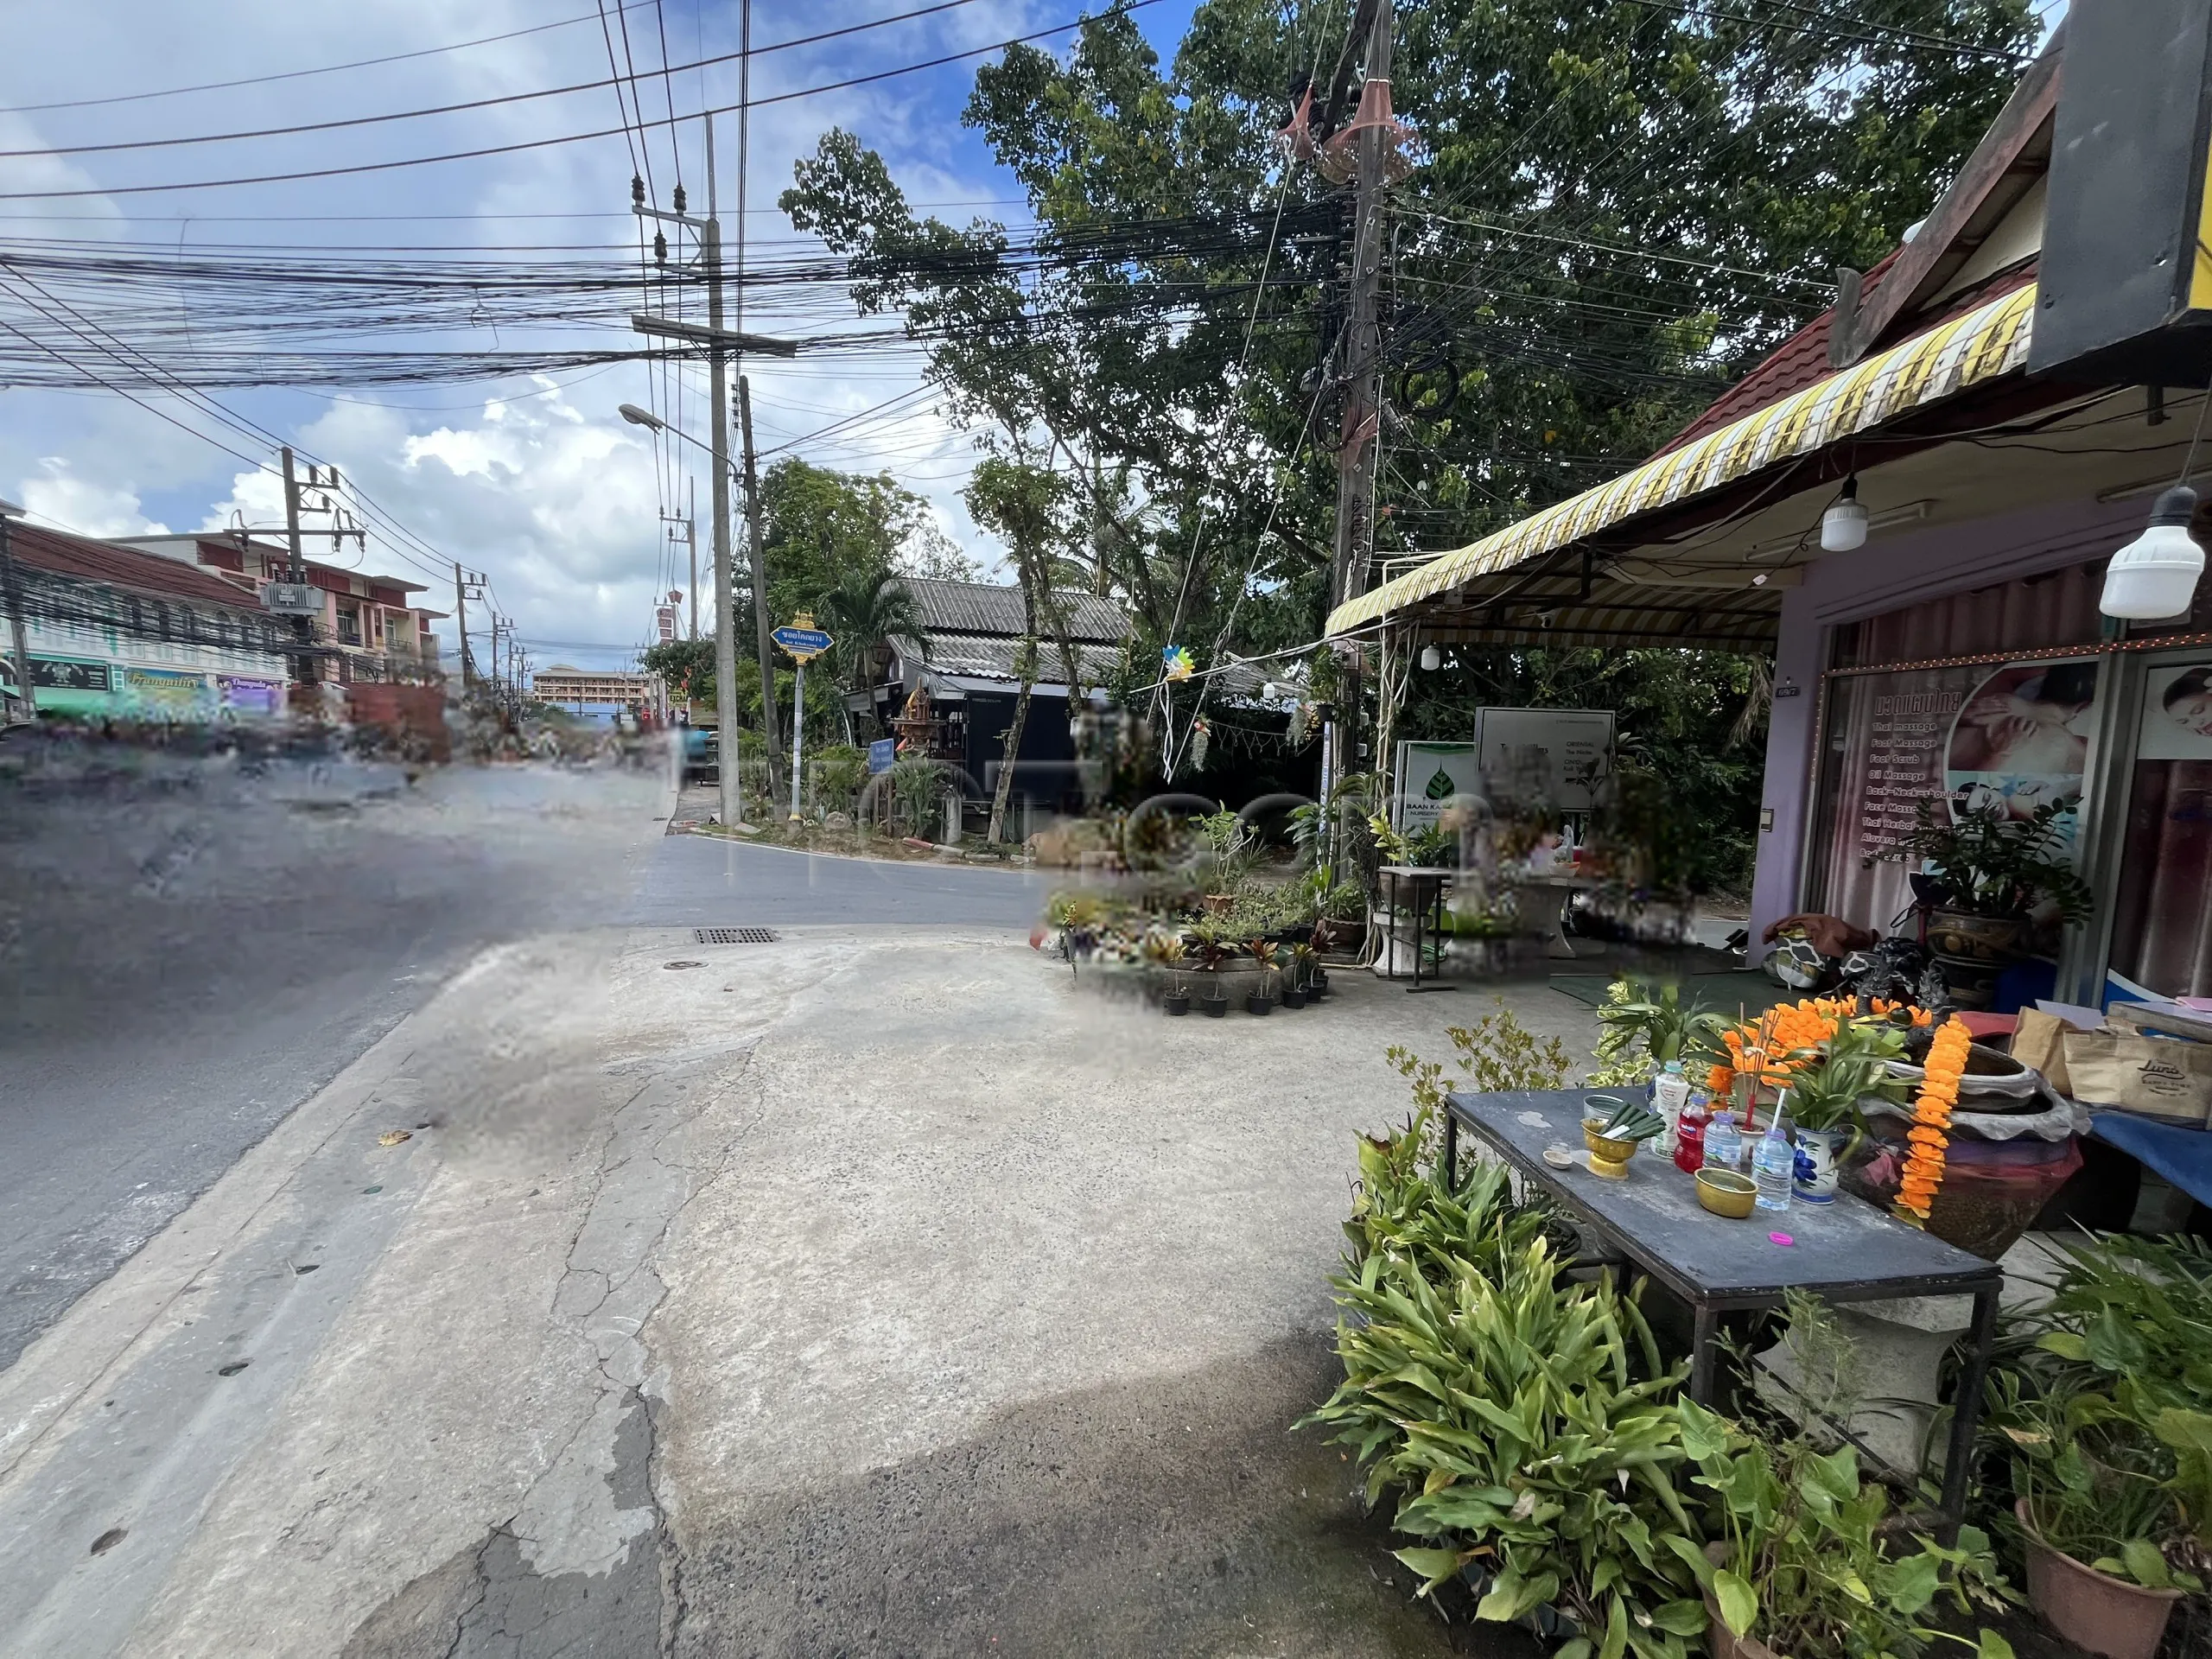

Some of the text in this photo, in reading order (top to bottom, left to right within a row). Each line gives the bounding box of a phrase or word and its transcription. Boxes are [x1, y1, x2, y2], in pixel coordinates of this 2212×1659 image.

[1875, 688, 1962, 715] นวดแผนไทย
[1872, 722, 1937, 733] Thai massage
[1871, 739, 1937, 749] Foot Massage
[1870, 754, 1920, 764] Foot Scrub
[1868, 770, 1925, 782] Oil Massage
[1865, 802, 1919, 814] Face Massa
[1862, 817, 1882, 827] Thai
[1884, 818, 1916, 830] Herbal
